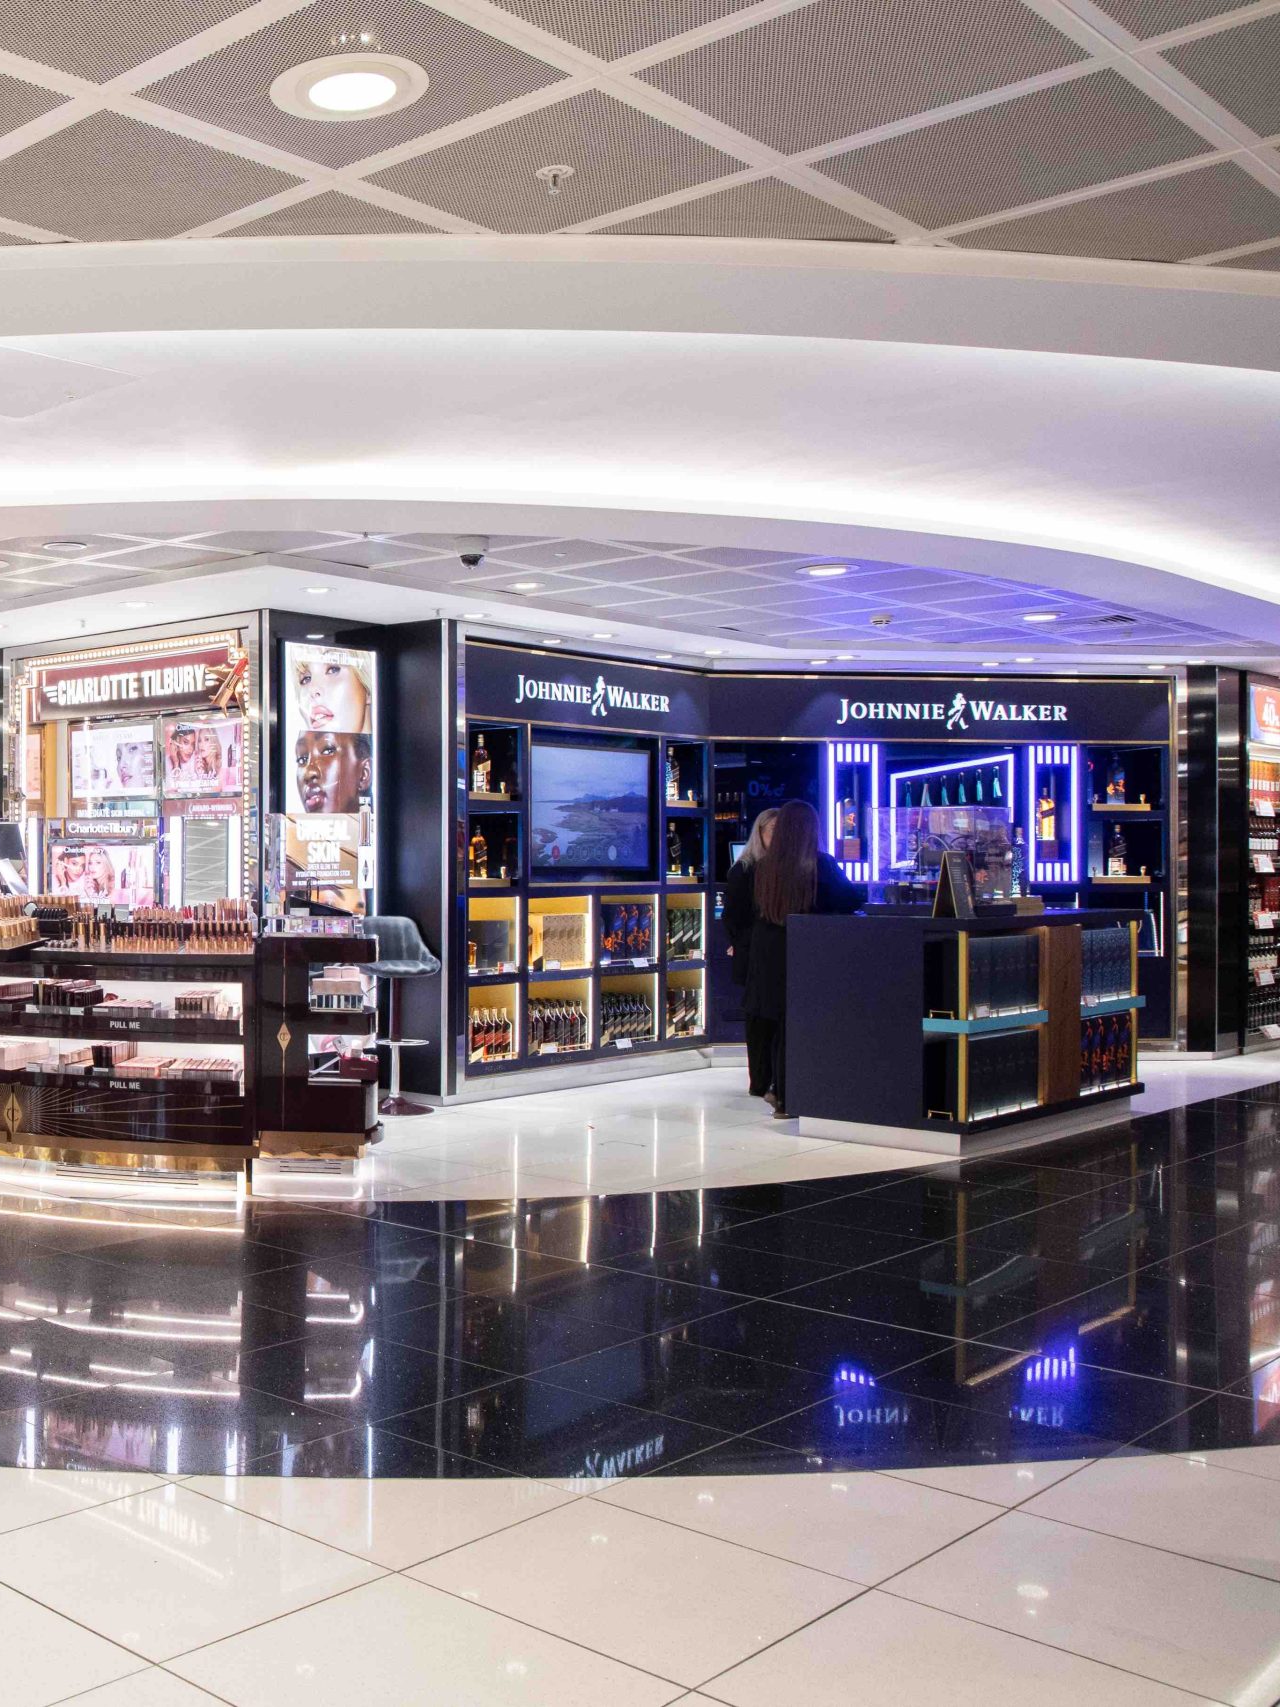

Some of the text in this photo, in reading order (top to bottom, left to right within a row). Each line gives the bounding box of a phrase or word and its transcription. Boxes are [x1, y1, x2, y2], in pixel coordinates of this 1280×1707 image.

[57, 664, 207, 706] CHARLOTTE TILBURY
[515, 675, 670, 713] JOHNNIE WALKER
[836, 698, 1069, 725] JOHNNIE WALKER
[68, 822, 138, 836] CharlotteTilbury
[308, 841, 341, 863] SKIN
[109, 1020, 141, 1029] PULL ME
[109, 1081, 128, 1089] PULL
[128, 1081, 141, 1090] ME
